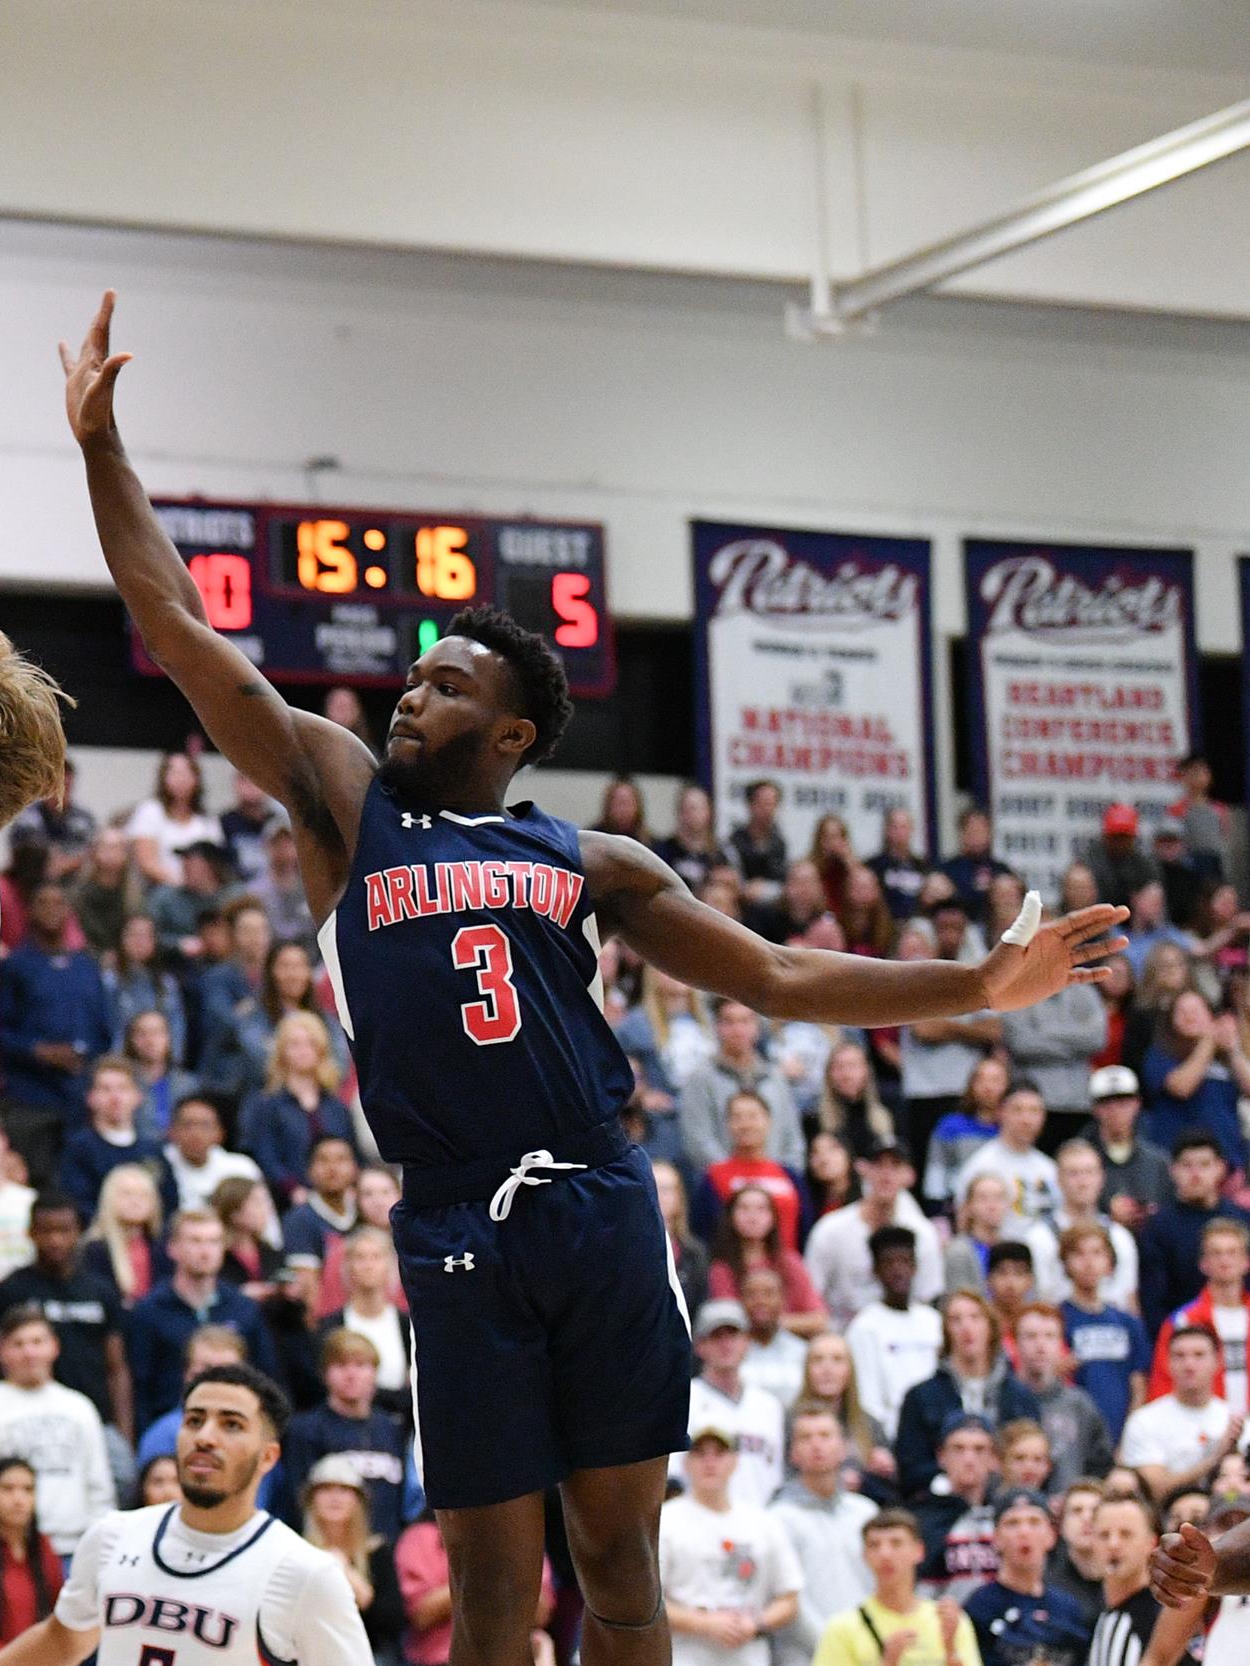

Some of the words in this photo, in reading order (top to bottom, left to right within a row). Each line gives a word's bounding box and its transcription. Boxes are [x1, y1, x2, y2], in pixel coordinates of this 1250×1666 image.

[297, 519, 479, 600] 15:16
[497, 526, 593, 566] GUEST
[708, 540, 919, 619] Patriots
[979, 556, 1183, 636] Patriots
[552, 573, 598, 648] 5
[1007, 679, 1165, 711] HEARTLAND
[741, 705, 893, 744] NATIONAL
[1003, 714, 1175, 746] CONFERENCE
[728, 736, 909, 779] CHAMPIONS
[1003, 750, 1185, 784] CHAMPIONS
[364, 860, 585, 932] ARLINGTON
[450, 923, 522, 1046] 3
[103, 1592, 239, 1650] DBU
